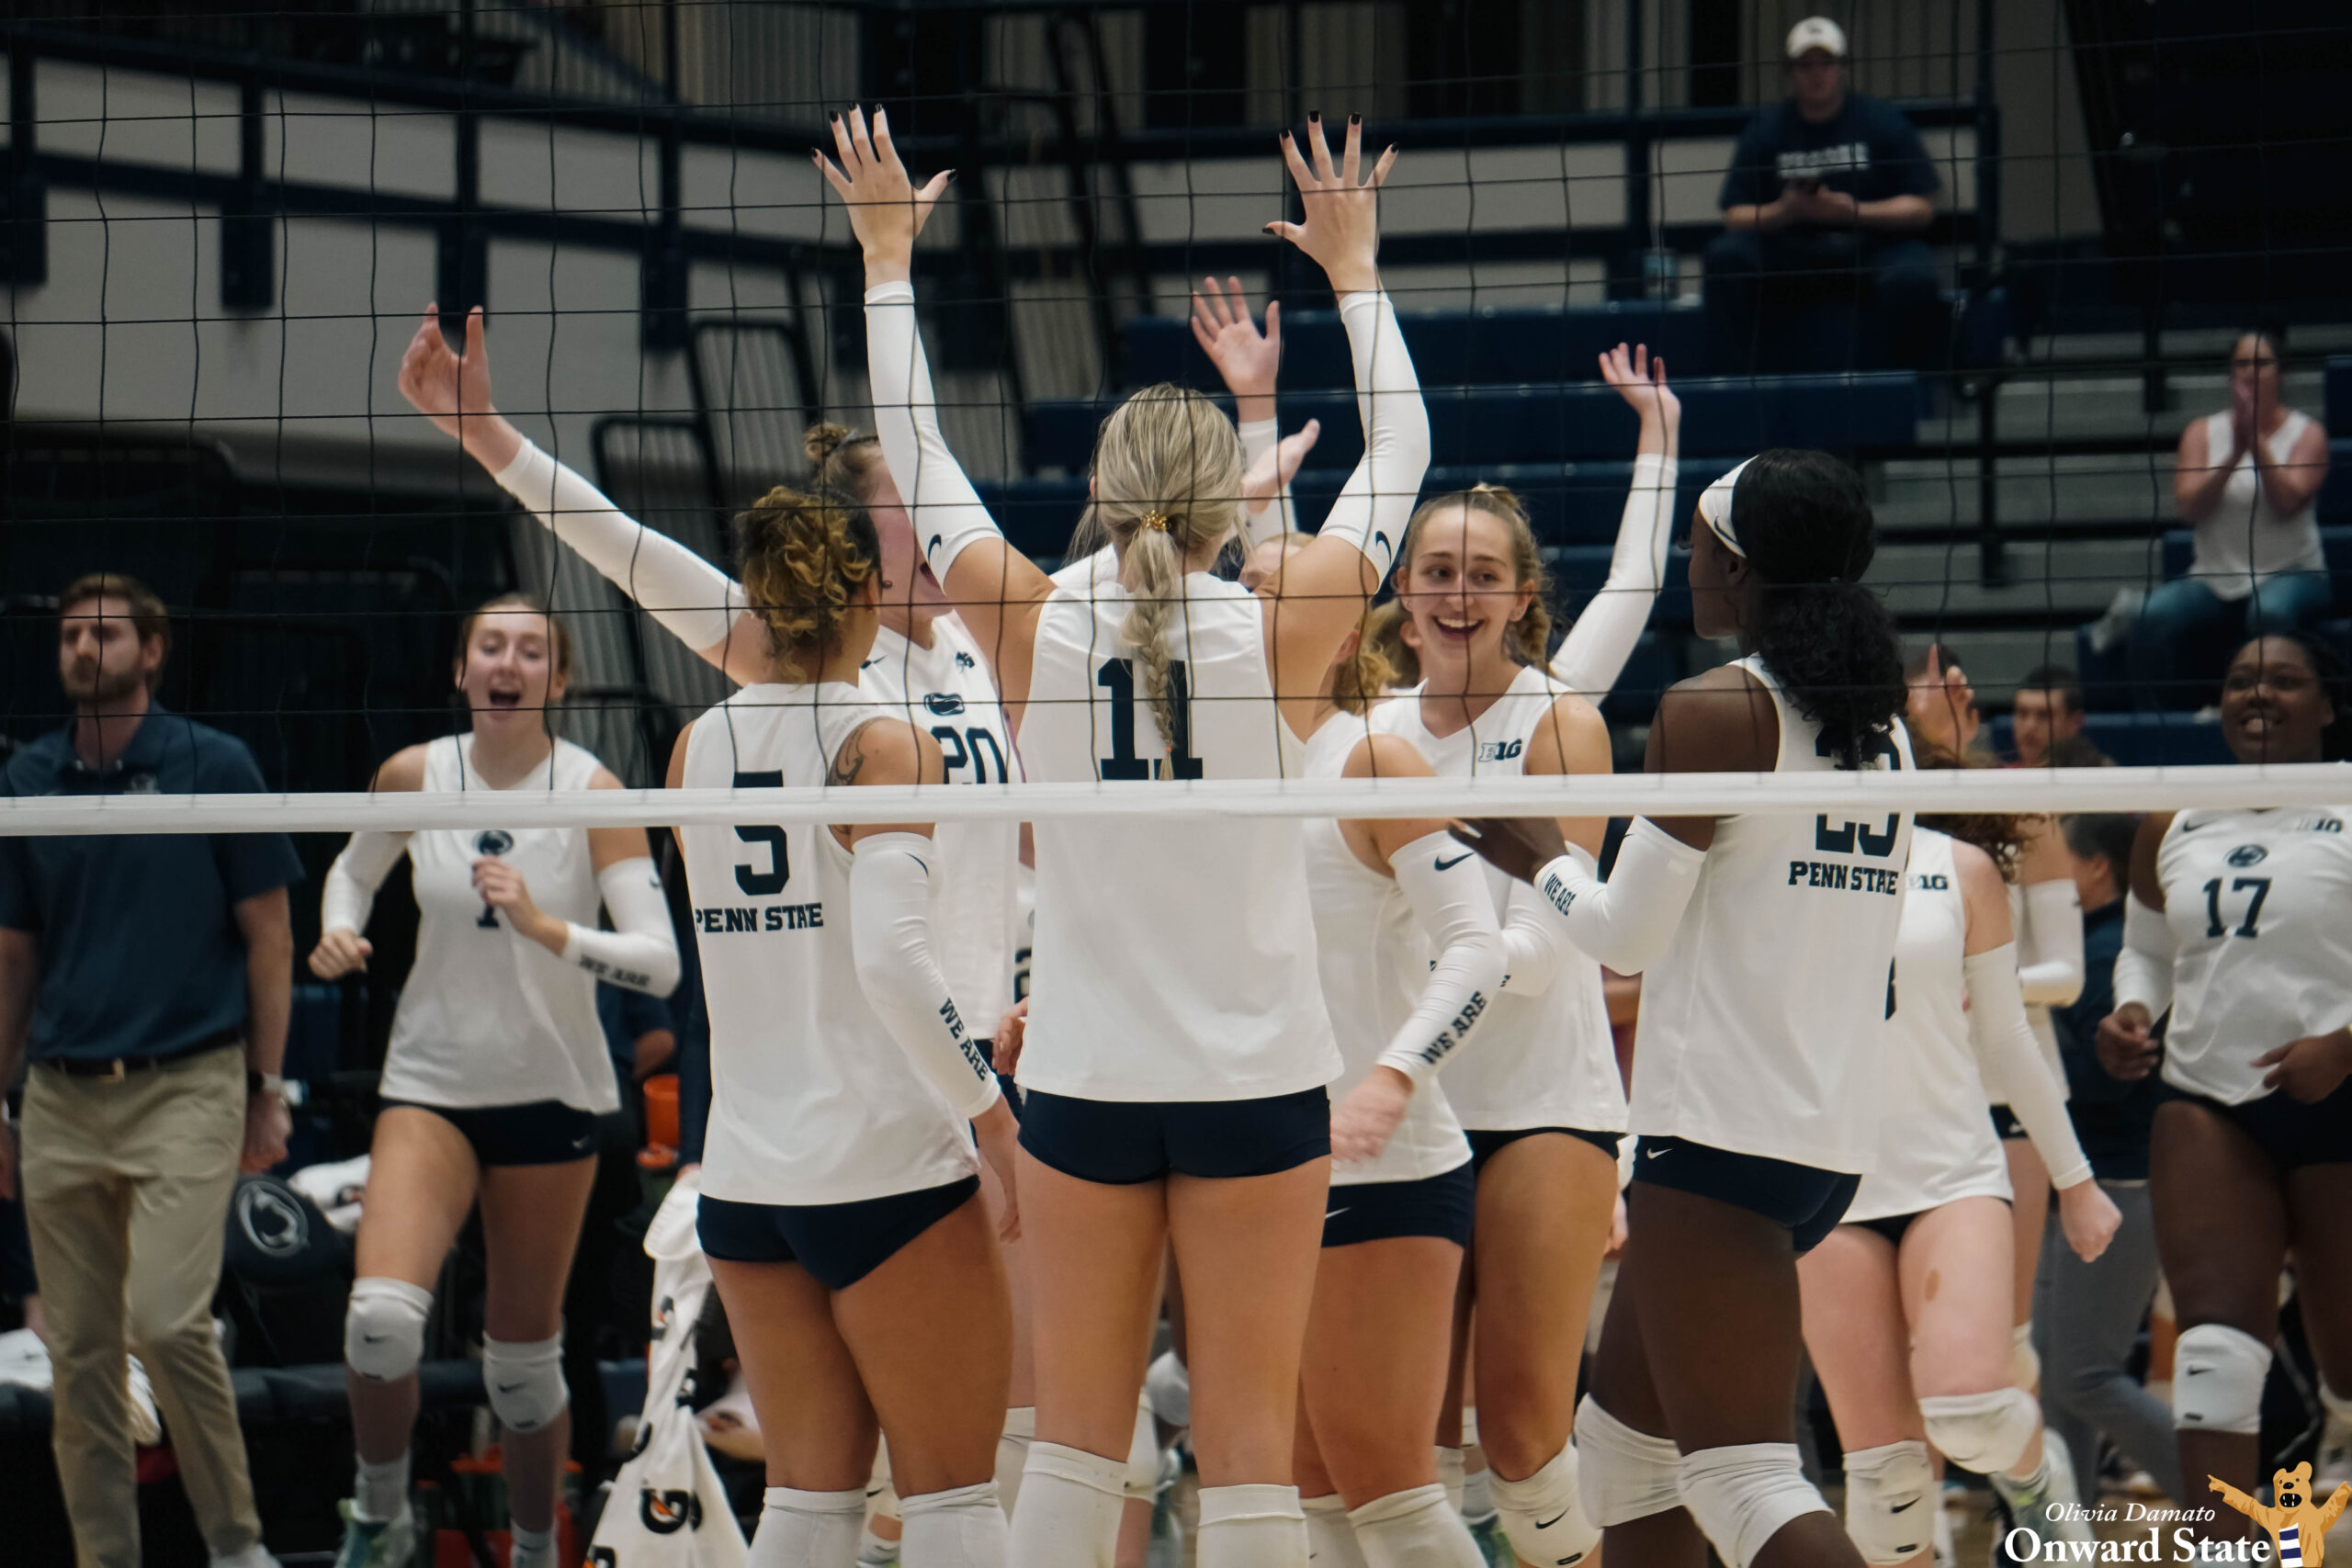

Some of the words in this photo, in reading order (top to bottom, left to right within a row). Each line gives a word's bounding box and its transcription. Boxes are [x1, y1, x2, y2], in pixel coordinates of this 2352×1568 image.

[1098, 658, 1204, 780] 11
[931, 726, 1008, 784] 20
[732, 770, 790, 897] 5
[1544, 873, 1562, 902] WE
[1788, 861, 1849, 889] PENN
[1850, 866, 1899, 896] STAE
[2203, 877, 2273, 938] 17
[764, 902, 824, 931] STAE
[939, 997, 965, 1040] WE
[959, 1036, 989, 1081] ARE
[1419, 1032, 1455, 1065] WE
[1451, 990, 1487, 1038] ARE
